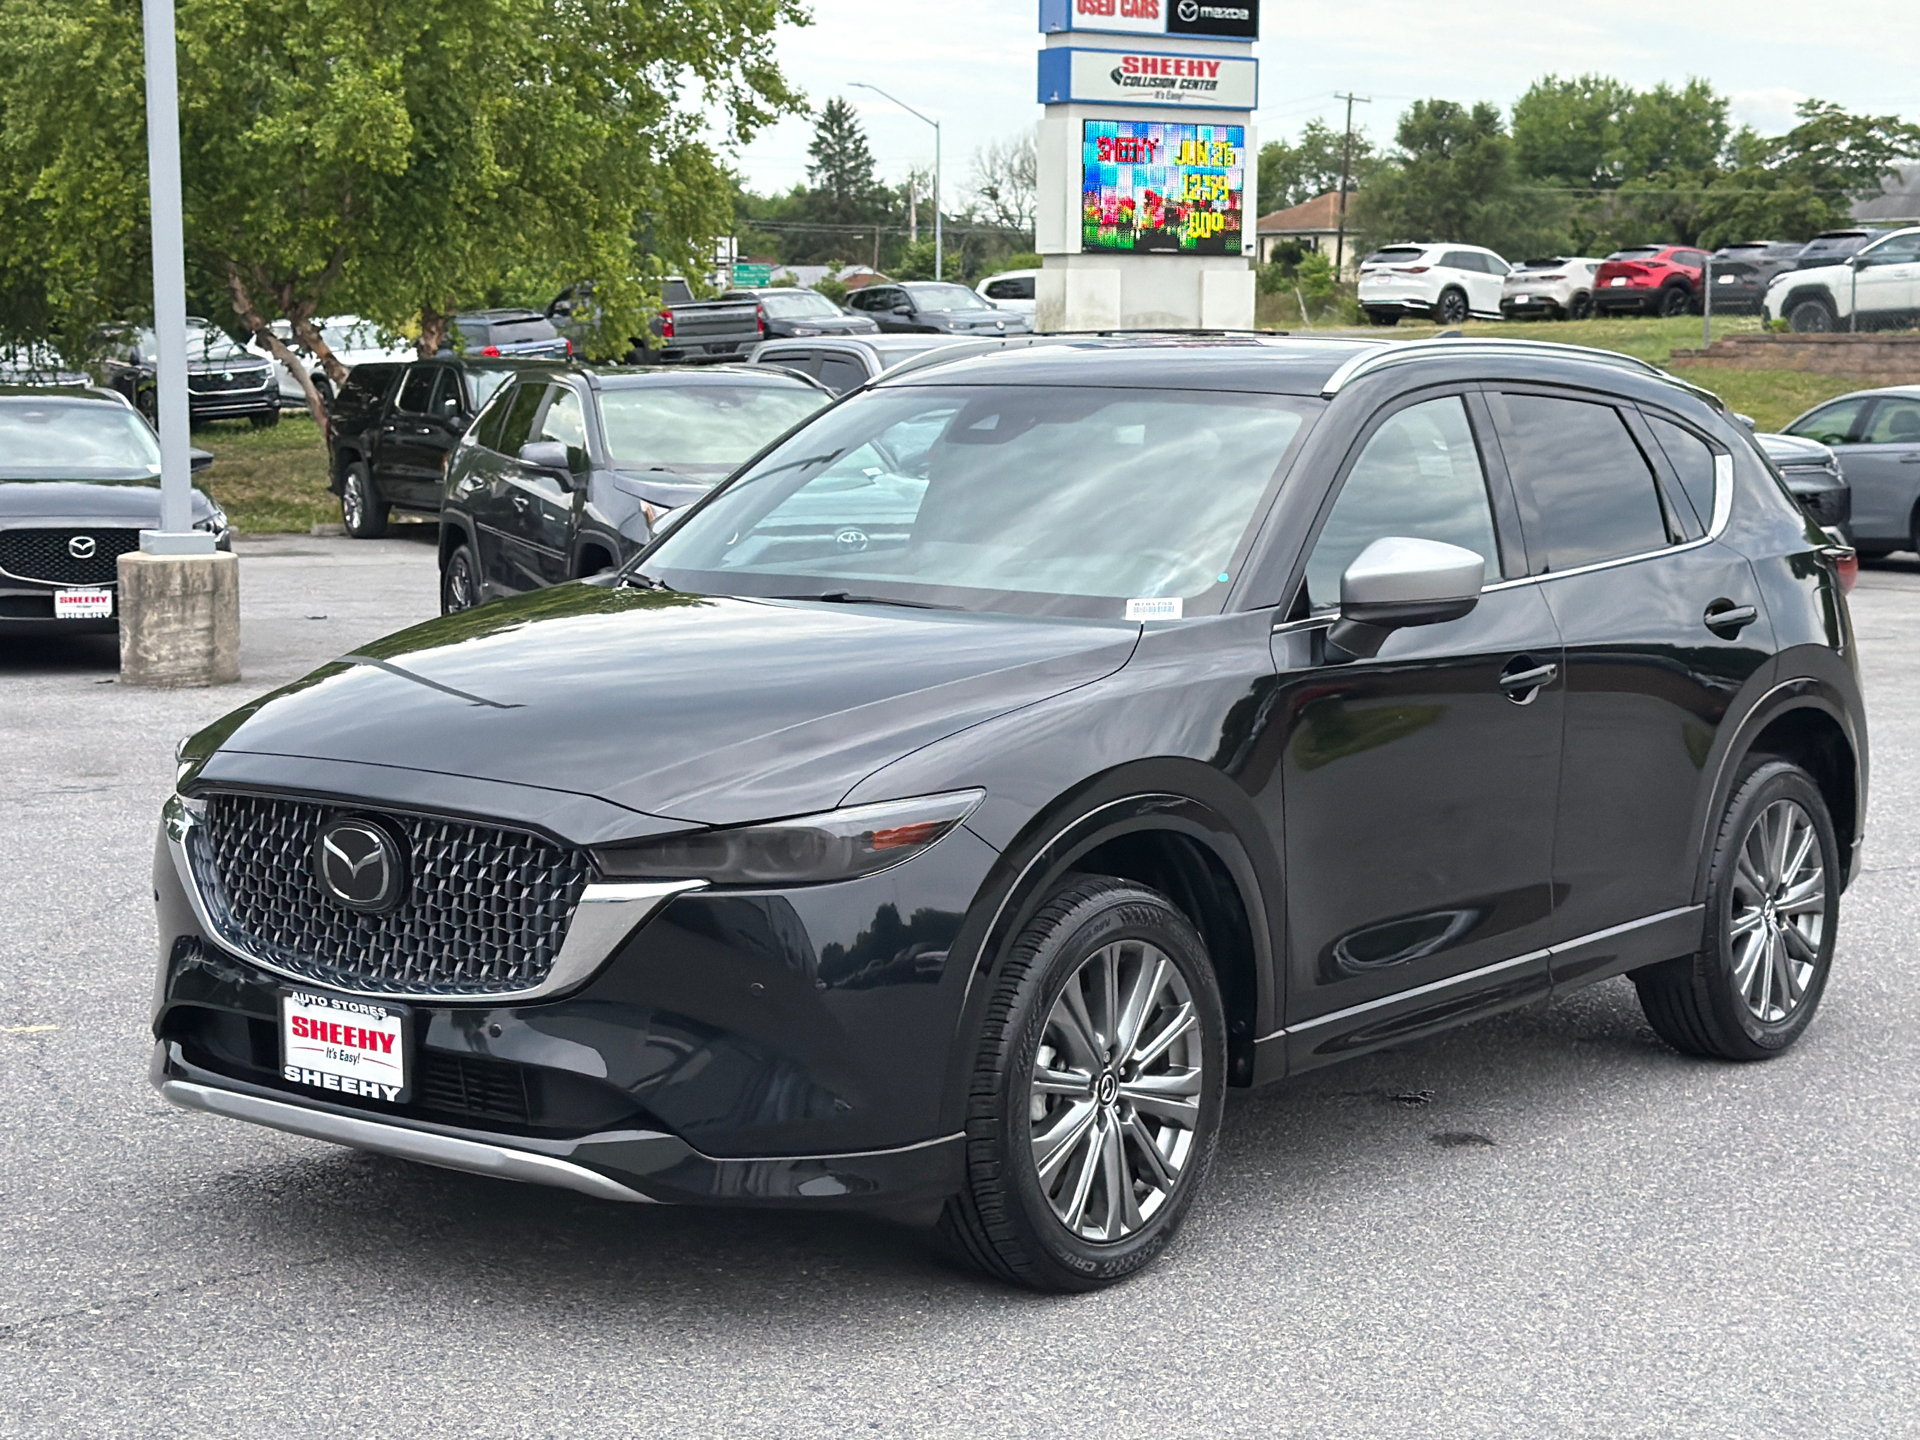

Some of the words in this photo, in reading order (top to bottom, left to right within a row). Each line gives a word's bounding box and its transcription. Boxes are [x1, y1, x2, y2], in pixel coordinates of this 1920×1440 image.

[1077, 0, 1116, 17] USED
[1120, 0, 1159, 20] CARS
[1200, 6, 1250, 20] mazda
[1122, 56, 1221, 78] SHEEHY
[1122, 75, 1178, 89] COLLISION
[1179, 79, 1218, 91] CENTER
[1175, 140, 1209, 166] JUN
[59, 596, 108, 604] SHEEHY
[292, 991, 328, 1007] AUTO
[331, 999, 388, 1018] STORES
[292, 1015, 396, 1054] SHEEHY
[326, 1047, 338, 1060] It's
[339, 1049, 361, 1066] Easy!
[284, 1065, 401, 1102] SHEEHY
